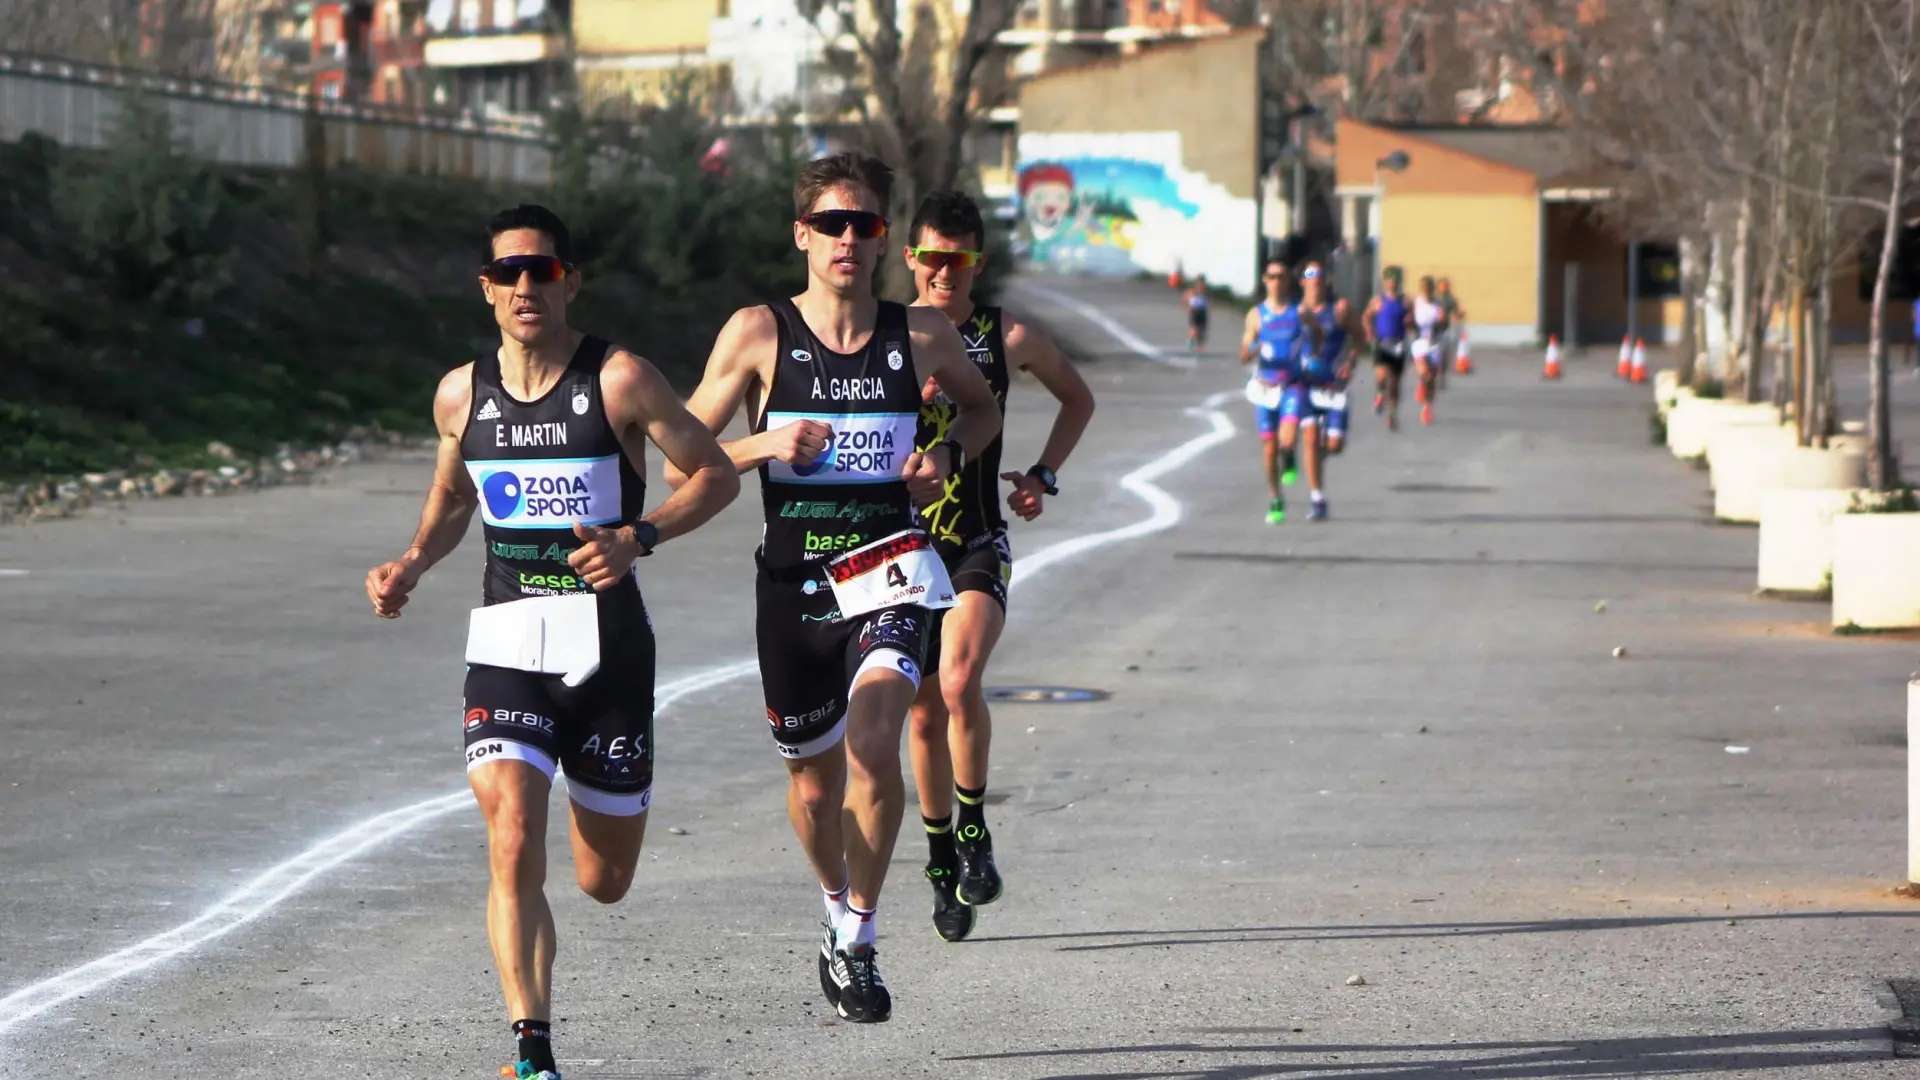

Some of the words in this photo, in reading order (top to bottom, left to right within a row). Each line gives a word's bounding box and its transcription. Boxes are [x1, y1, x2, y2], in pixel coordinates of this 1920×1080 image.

[811, 376, 826, 400] A.
[830, 376, 885, 401] GARCIA
[496, 424, 508, 447] E.
[511, 422, 567, 447] MARTIN
[835, 452, 894, 472] SPORT
[526, 496, 591, 517] SPORT
[886, 562, 909, 588] 4
